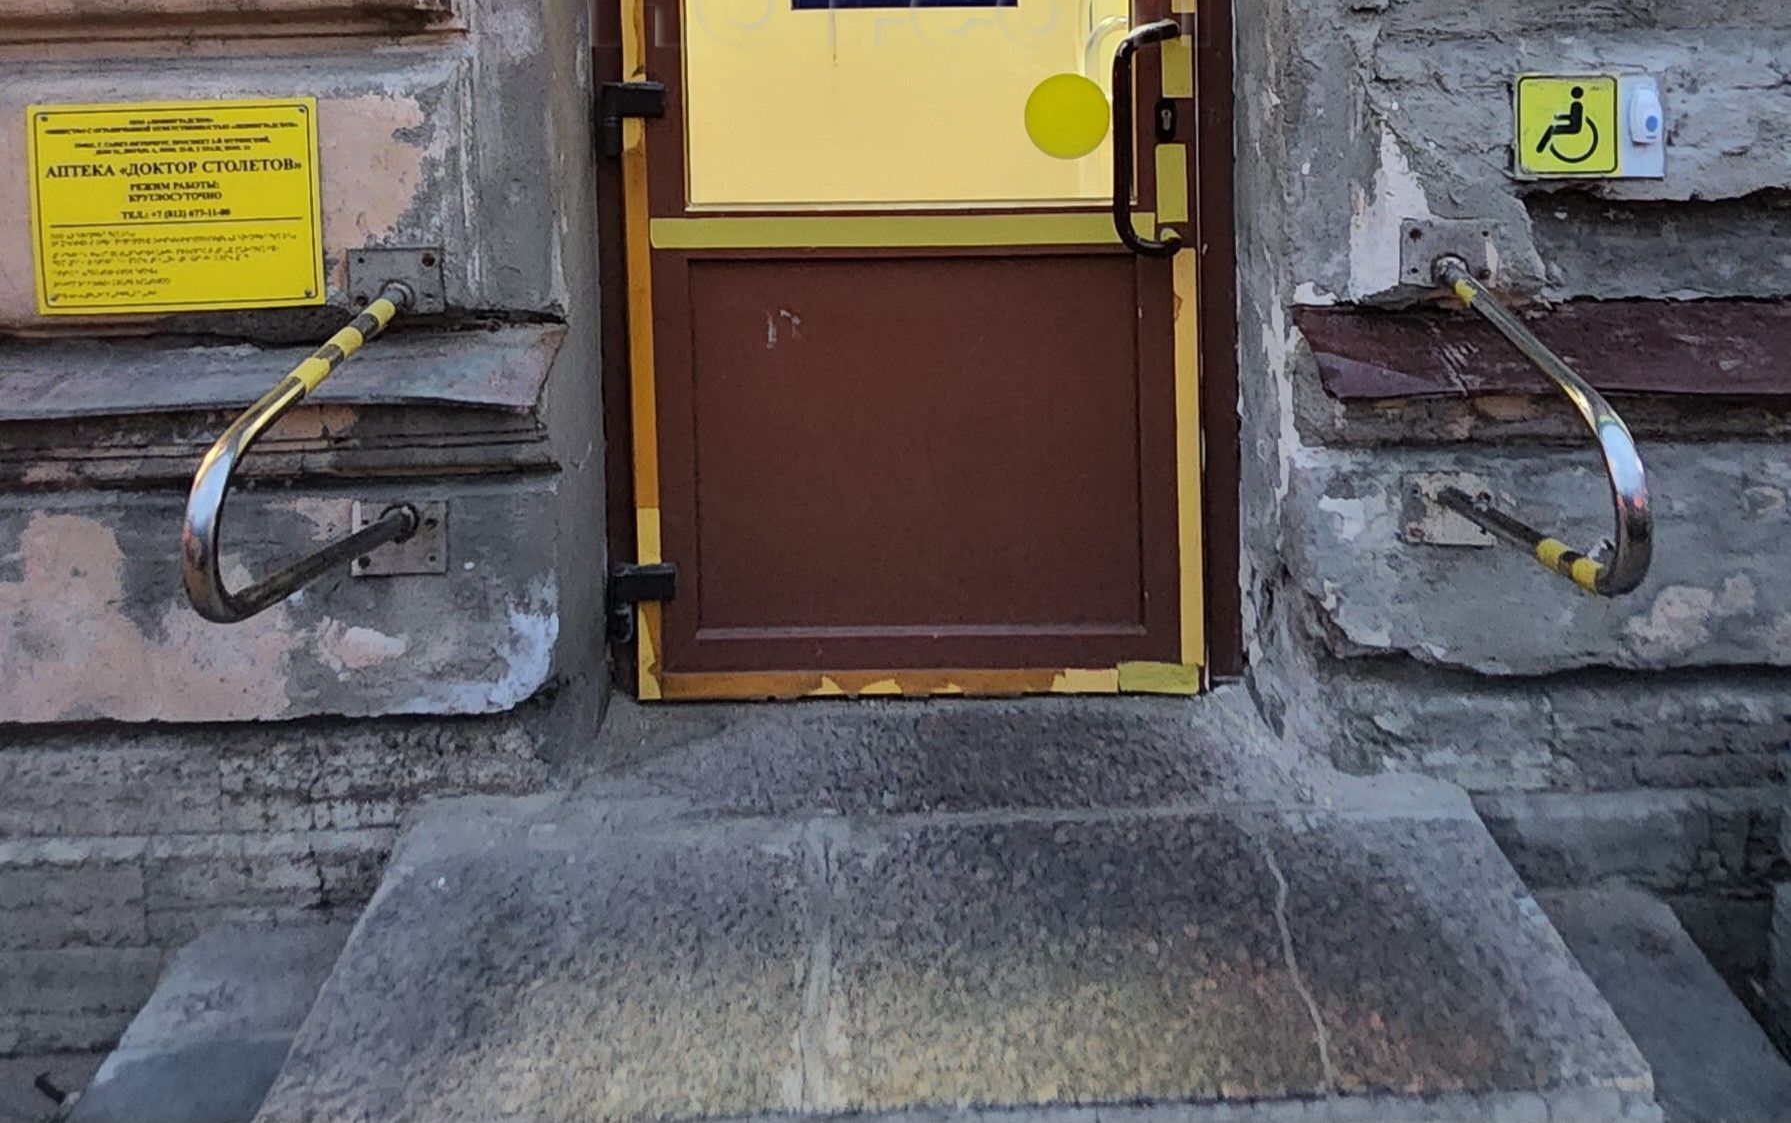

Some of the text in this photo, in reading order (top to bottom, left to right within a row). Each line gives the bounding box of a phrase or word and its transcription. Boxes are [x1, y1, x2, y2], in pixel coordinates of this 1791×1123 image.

[45, 158, 302, 178] АПТЕКА «ДОКТОР СТОЛЕТОВ»
[130, 182, 170, 191] РЕЖИМ
[129, 192, 222, 202] КРУГЛОСУТОЧНО
